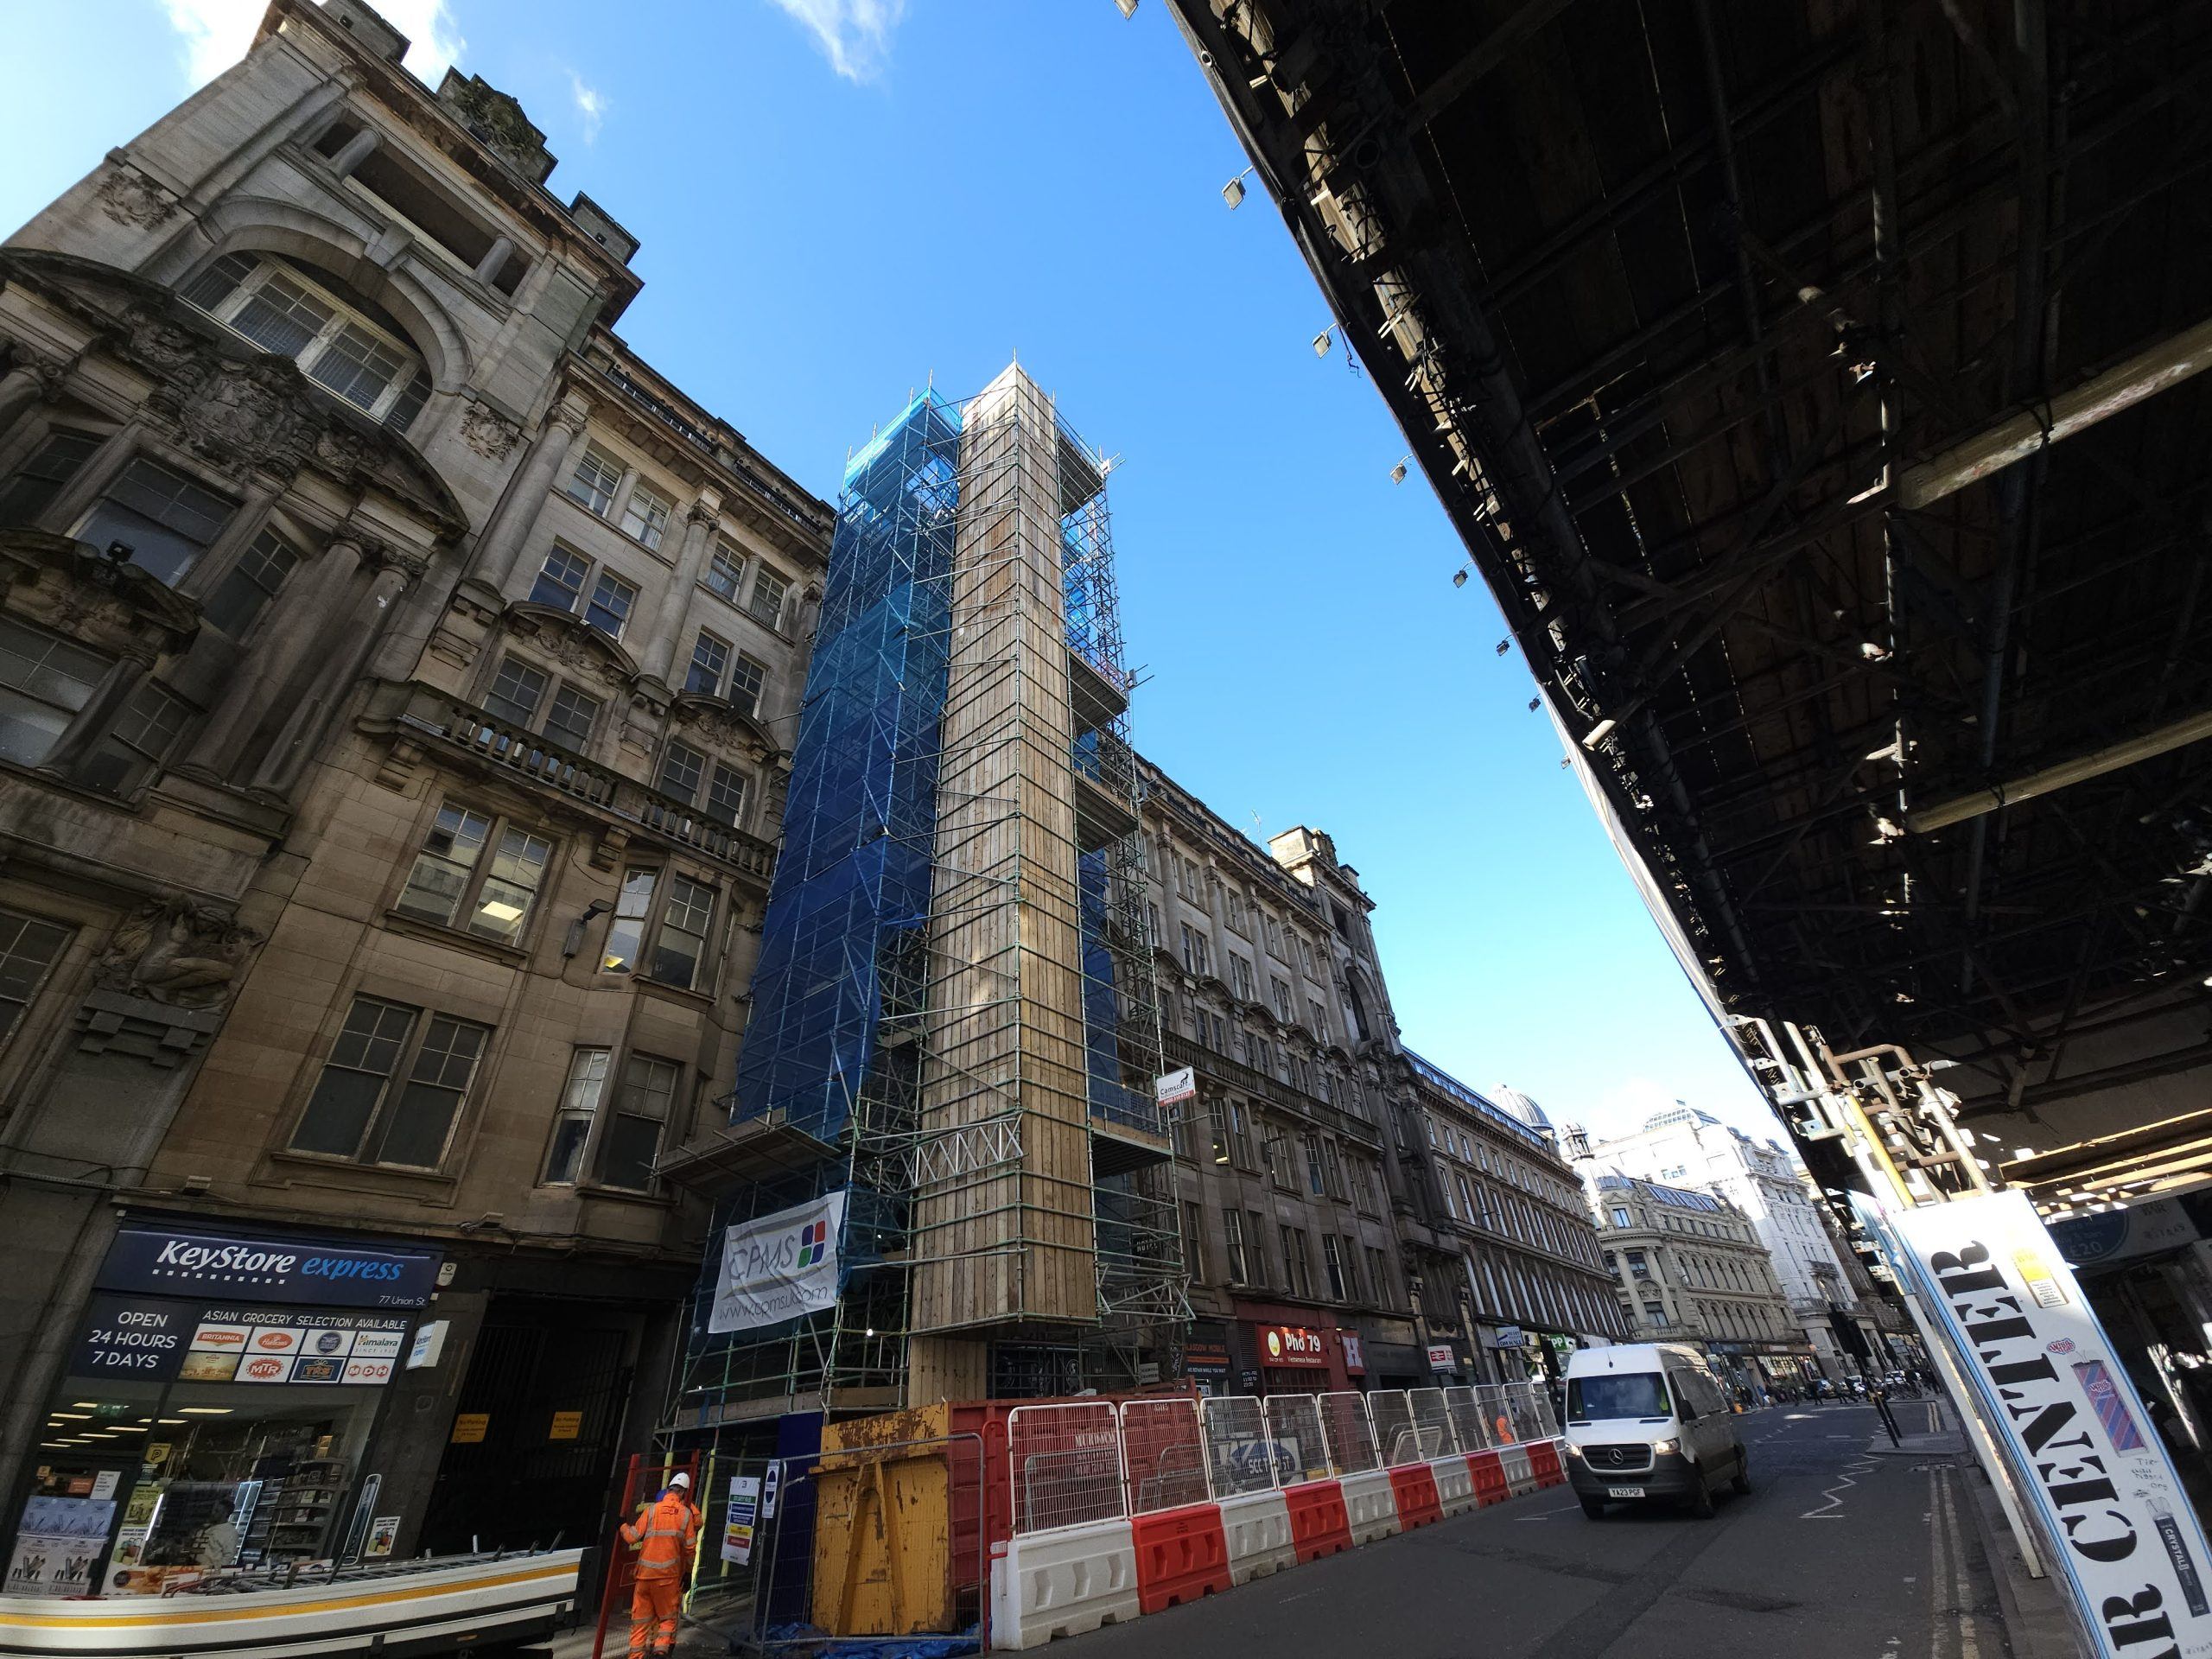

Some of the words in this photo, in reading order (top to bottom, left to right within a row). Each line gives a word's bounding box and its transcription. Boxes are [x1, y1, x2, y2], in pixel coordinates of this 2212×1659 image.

[156, 1240, 296, 1274] KeyStore
[302, 1255, 405, 1281] express
[728, 1234, 796, 1281] CPMS
[378, 1294, 391, 1304] 77
[391, 1295, 414, 1305] Union
[118, 1311, 168, 1327] OPEN
[202, 1310, 239, 1322] ASIAN
[242, 1313, 294, 1325] GROCERY
[296, 1314, 353, 1328] SELECTION
[355, 1318, 408, 1330] AVAILABLE
[88, 1329, 111, 1344] 24
[114, 1332, 178, 1349] HOURS
[201, 1333, 240, 1342] BRITANNIA
[1307, 1334, 1321, 1352] 79
[91, 1351, 105, 1364] 7
[105, 1351, 160, 1369] DAYS
[250, 1363, 279, 1375] MTR
[1930, 1239, 2138, 1563] CENTER
[1611, 1488, 1627, 1497] YA23
